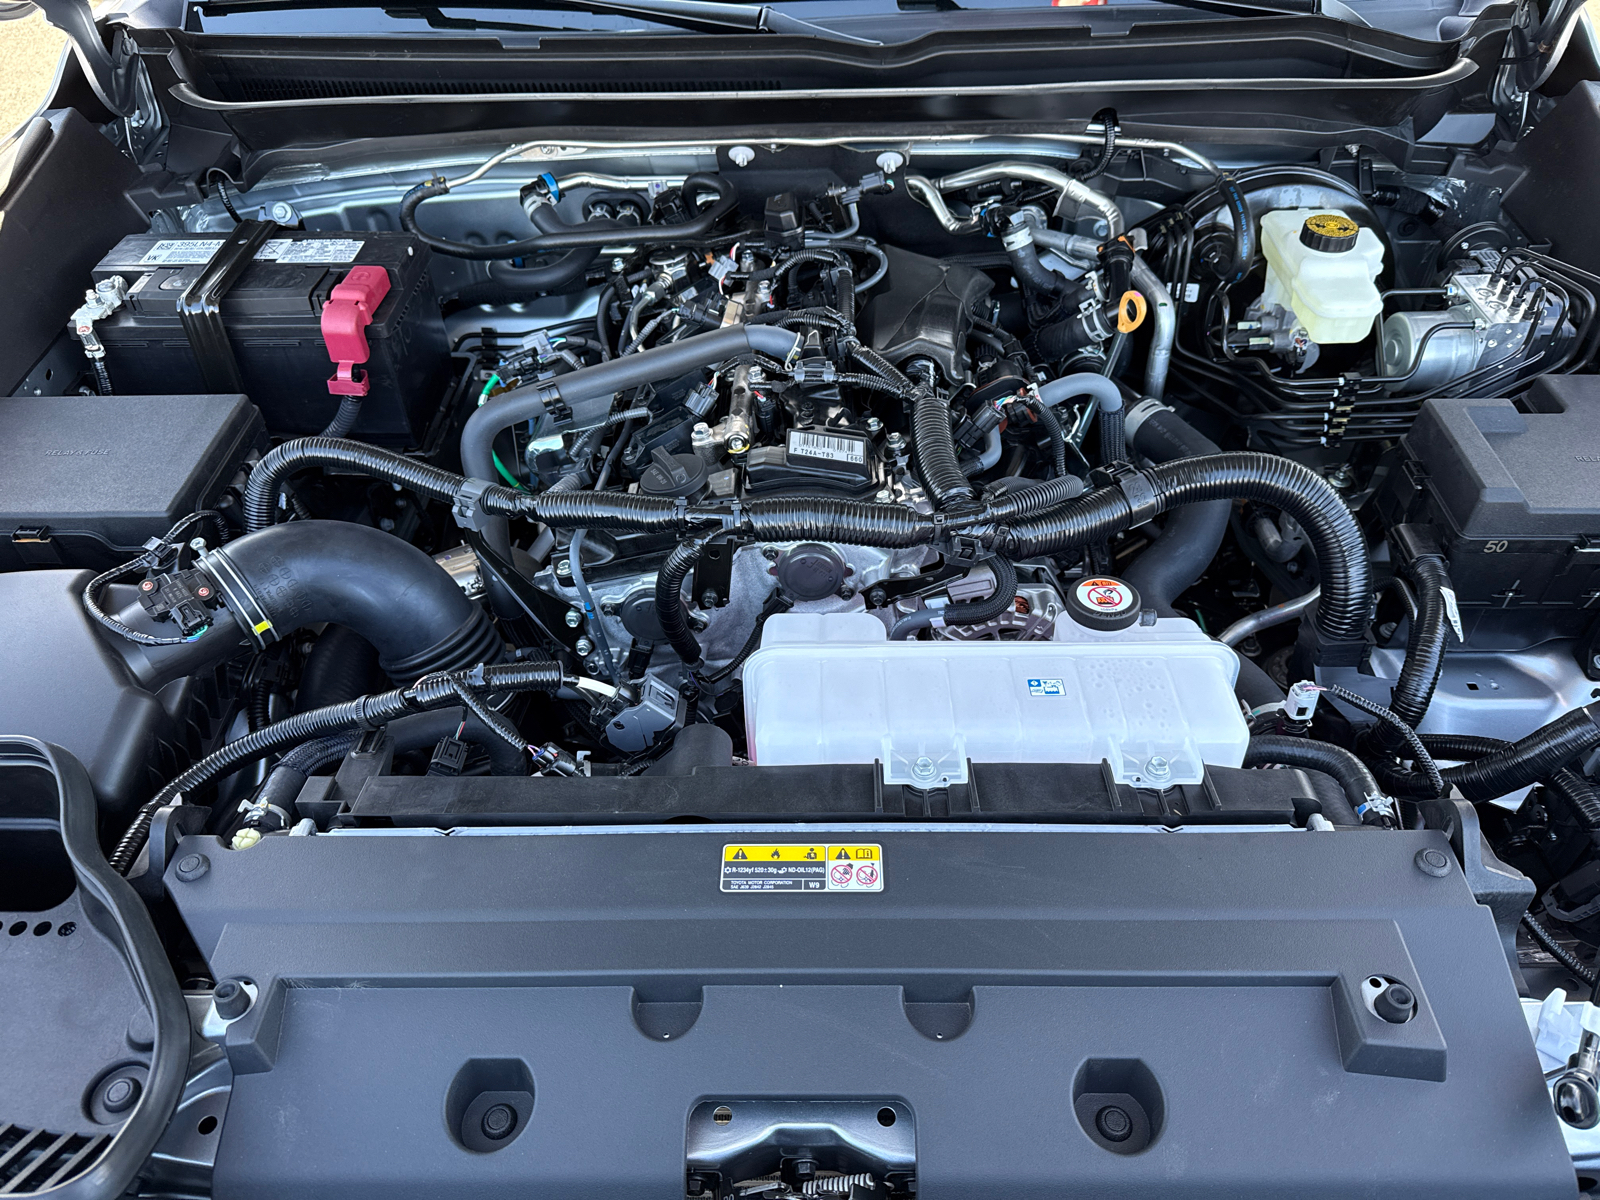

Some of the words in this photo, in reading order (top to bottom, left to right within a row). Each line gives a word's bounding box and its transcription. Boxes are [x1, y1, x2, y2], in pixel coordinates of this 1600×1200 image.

[85, 448, 111, 456] FUSE
[800, 448, 834, 459] T24A-T83
[1483, 540, 1508, 553] 50
